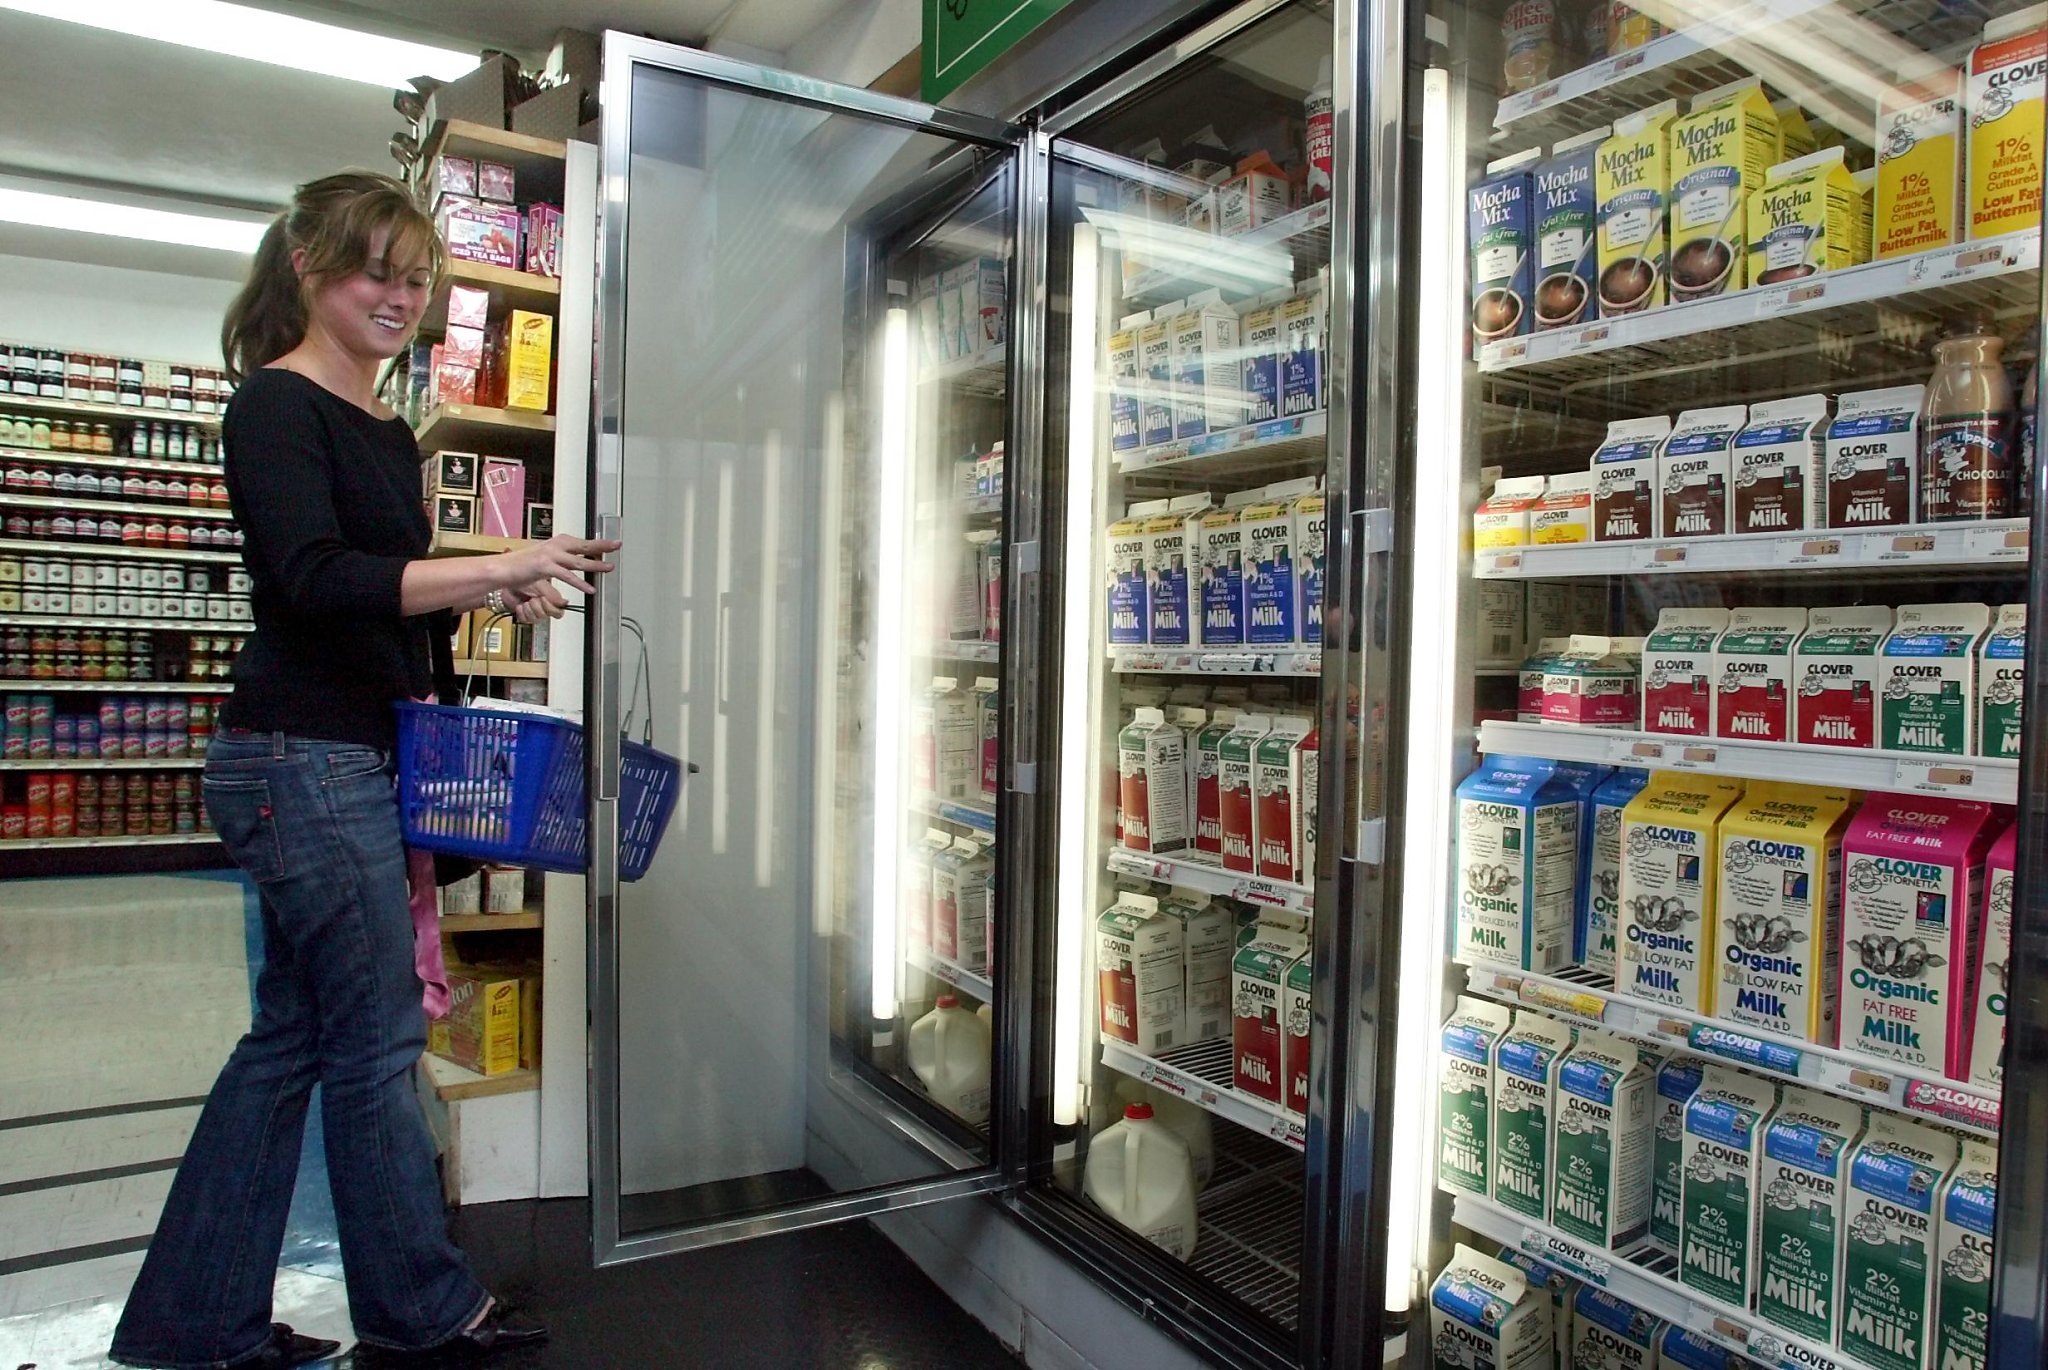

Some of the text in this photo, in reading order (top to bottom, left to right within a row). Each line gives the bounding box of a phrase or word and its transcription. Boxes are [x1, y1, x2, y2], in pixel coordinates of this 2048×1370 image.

[1988, 60, 2046, 88] CLOVE
[1894, 100, 1954, 127] CLOVER
[1676, 116, 1736, 149] Mocha
[1686, 141, 1724, 167] Mix
[1997, 135, 2030, 157] 1%
[1601, 143, 1655, 173] Mocha
[1992, 151, 2033, 169] Milkfat
[1537, 165, 1588, 194] Mocha
[1611, 166, 1644, 189] Mix
[1680, 167, 1731, 190] Original
[1900, 171, 1928, 191] 1%
[1986, 172, 2039, 192] Cultured
[1473, 184, 1521, 212] Mocha
[1546, 187, 1579, 210] Mix
[1605, 191, 1651, 213] Original
[1762, 189, 1812, 215] Mocha
[1896, 186, 1930, 202] Milkfat
[1983, 187, 2041, 210] Low Fat
[1481, 206, 1511, 227] Mix
[1562, 212, 1584, 226] Free
[1770, 210, 1803, 229] Mix
[1891, 206, 1935, 223] Cultured
[1973, 200, 2041, 226] Buttermil
[1495, 228, 1517, 243] Free
[1888, 219, 1937, 239] Low Fat
[1880, 229, 1947, 253] Buttermilk
[452, 247, 511, 263] ICED TEA BAGS
[1806, 288, 1824, 298] 1.59
[1251, 327, 1276, 340] CLOVER
[1288, 317, 1315, 331] CLOVER
[1290, 364, 1304, 376] 1%
[1285, 393, 1314, 416] Milk
[1113, 418, 1137, 438] Milk
[1145, 410, 1170, 432] Milk
[1743, 452, 1785, 465] CLOVER
[1839, 443, 1888, 457] CLOVER
[1601, 468, 1636, 480] CLOVER
[1671, 460, 1708, 473] CLOVER
[1749, 508, 1789, 527] Milk
[1845, 503, 1892, 522] Milk
[1252, 525, 1287, 540] CLOVER
[1606, 520, 1639, 537] Milk
[1675, 515, 1711, 533] Milk
[1114, 542, 1143, 553] CLOVER
[1154, 536, 1182, 549] CLOVER
[1208, 532, 1241, 545] CLOVER
[1914, 541, 1935, 550] 1.25
[1113, 611, 1139, 629] Milk
[1155, 610, 1181, 629] Milk
[1207, 609, 1236, 628] Milk
[1252, 605, 1284, 626] Milk
[1655, 660, 1694, 670] CLOVER
[1726, 662, 1768, 673] CLOVER
[1808, 664, 1853, 675] CLOVER
[1893, 666, 1942, 678] CLOVER
[1595, 679, 1621, 688] CLOVER
[1910, 694, 1933, 707] 2%
[1658, 711, 1695, 729] Milk
[1731, 719, 1771, 735] Milk
[1813, 721, 1856, 740] Milk
[1898, 727, 1945, 747] Milk
[1225, 763, 1249, 774] CLOVER
[1263, 767, 1288, 778] CLOVER
[1956, 775, 1972, 784] .89
[1477, 803, 1518, 819] CLOVER
[1749, 809, 1787, 819] Organic
[1764, 801, 1817, 812] CLOVER
[1887, 809, 1949, 825] CLOVER
[1125, 819, 1148, 838] Milk
[1645, 826, 1696, 845] CLOVER
[1224, 837, 1251, 859] Milk
[1262, 843, 1290, 865] Milk
[1651, 840, 1695, 852] STORNETTA
[1747, 839, 1805, 861] CLOVER
[1754, 855, 1803, 869] STORNETTA
[1875, 858, 1943, 882] CLOVER
[1250, 881, 1272, 893] CLOVER
[1883, 874, 1940, 890] STORNETTA
[1463, 891, 1518, 915] Organic
[1104, 939, 1131, 954] CLOVER
[1471, 927, 1506, 950] Milk
[1626, 925, 1694, 954] Organic
[1645, 953, 1694, 971] LOW FAT
[1726, 945, 1802, 977] Organic
[1636, 965, 1680, 993] Milk
[1747, 974, 1803, 997] LOW FAT
[1850, 968, 1939, 1005] Organic
[451, 981, 473, 1006] ton
[1240, 980, 1276, 1000] CLOVER
[1737, 988, 1787, 1018] Milk
[1863, 999, 1917, 1023] FAT FREE
[1105, 1004, 1130, 1029] Milk
[1713, 1031, 1762, 1052] CLOVER
[1862, 1016, 1921, 1049] Milk
[1856, 1038, 1891, 1056] Vitamin
[1893, 1049, 1904, 1061] A
[1916, 1053, 1925, 1064] D
[1155, 1066, 1174, 1081] CLOVER
[1240, 1058, 1272, 1085] Milk
[1450, 1059, 1487, 1080] CLOVER
[1507, 1076, 1546, 1098] CLOVER
[1869, 1078, 1889, 1092] 3.59
[1717, 1089, 1756, 1106] CLOVER
[1936, 1088, 2000, 1115] CLOVER
[1569, 1097, 1611, 1121] CLOVER
[1452, 1112, 1473, 1129] 2%
[1798, 1112, 1841, 1130] CLOVER
[1508, 1132, 1530, 1151] 2%
[1942, 1126, 1989, 1144] CLOVER
[1443, 1143, 1484, 1177] Milk
[1698, 1142, 1749, 1168] CLOVER
[1888, 1142, 1934, 1162] CLOVER
[1569, 1155, 1593, 1174] 2%
[1498, 1165, 1541, 1200] Milk
[1779, 1167, 1835, 1195] CLOVER
[1557, 1189, 1604, 1227] Milk
[1700, 1204, 1728, 1227] 2%
[1866, 1200, 1928, 1232] CLOVER
[1549, 1238, 1585, 1261] CLOVER
[1781, 1234, 1812, 1257] 2%
[1684, 1242, 1742, 1286] Milk
[1469, 1268, 1507, 1291] CLOVER
[1866, 1269, 1900, 1295] 2%
[1764, 1273, 1827, 1320] Milk
[1849, 1284, 1887, 1309] Vitamin
[1888, 1303, 1898, 1314] A
[1909, 1311, 1918, 1321] D
[1865, 1283, 1901, 1304] Milkfat
[1853, 1299, 1912, 1330] Reduced Fat
[1443, 1321, 1494, 1356] CLOVER
[1847, 1307, 1916, 1360] Milk
[1588, 1325, 1643, 1366] CLOVER
